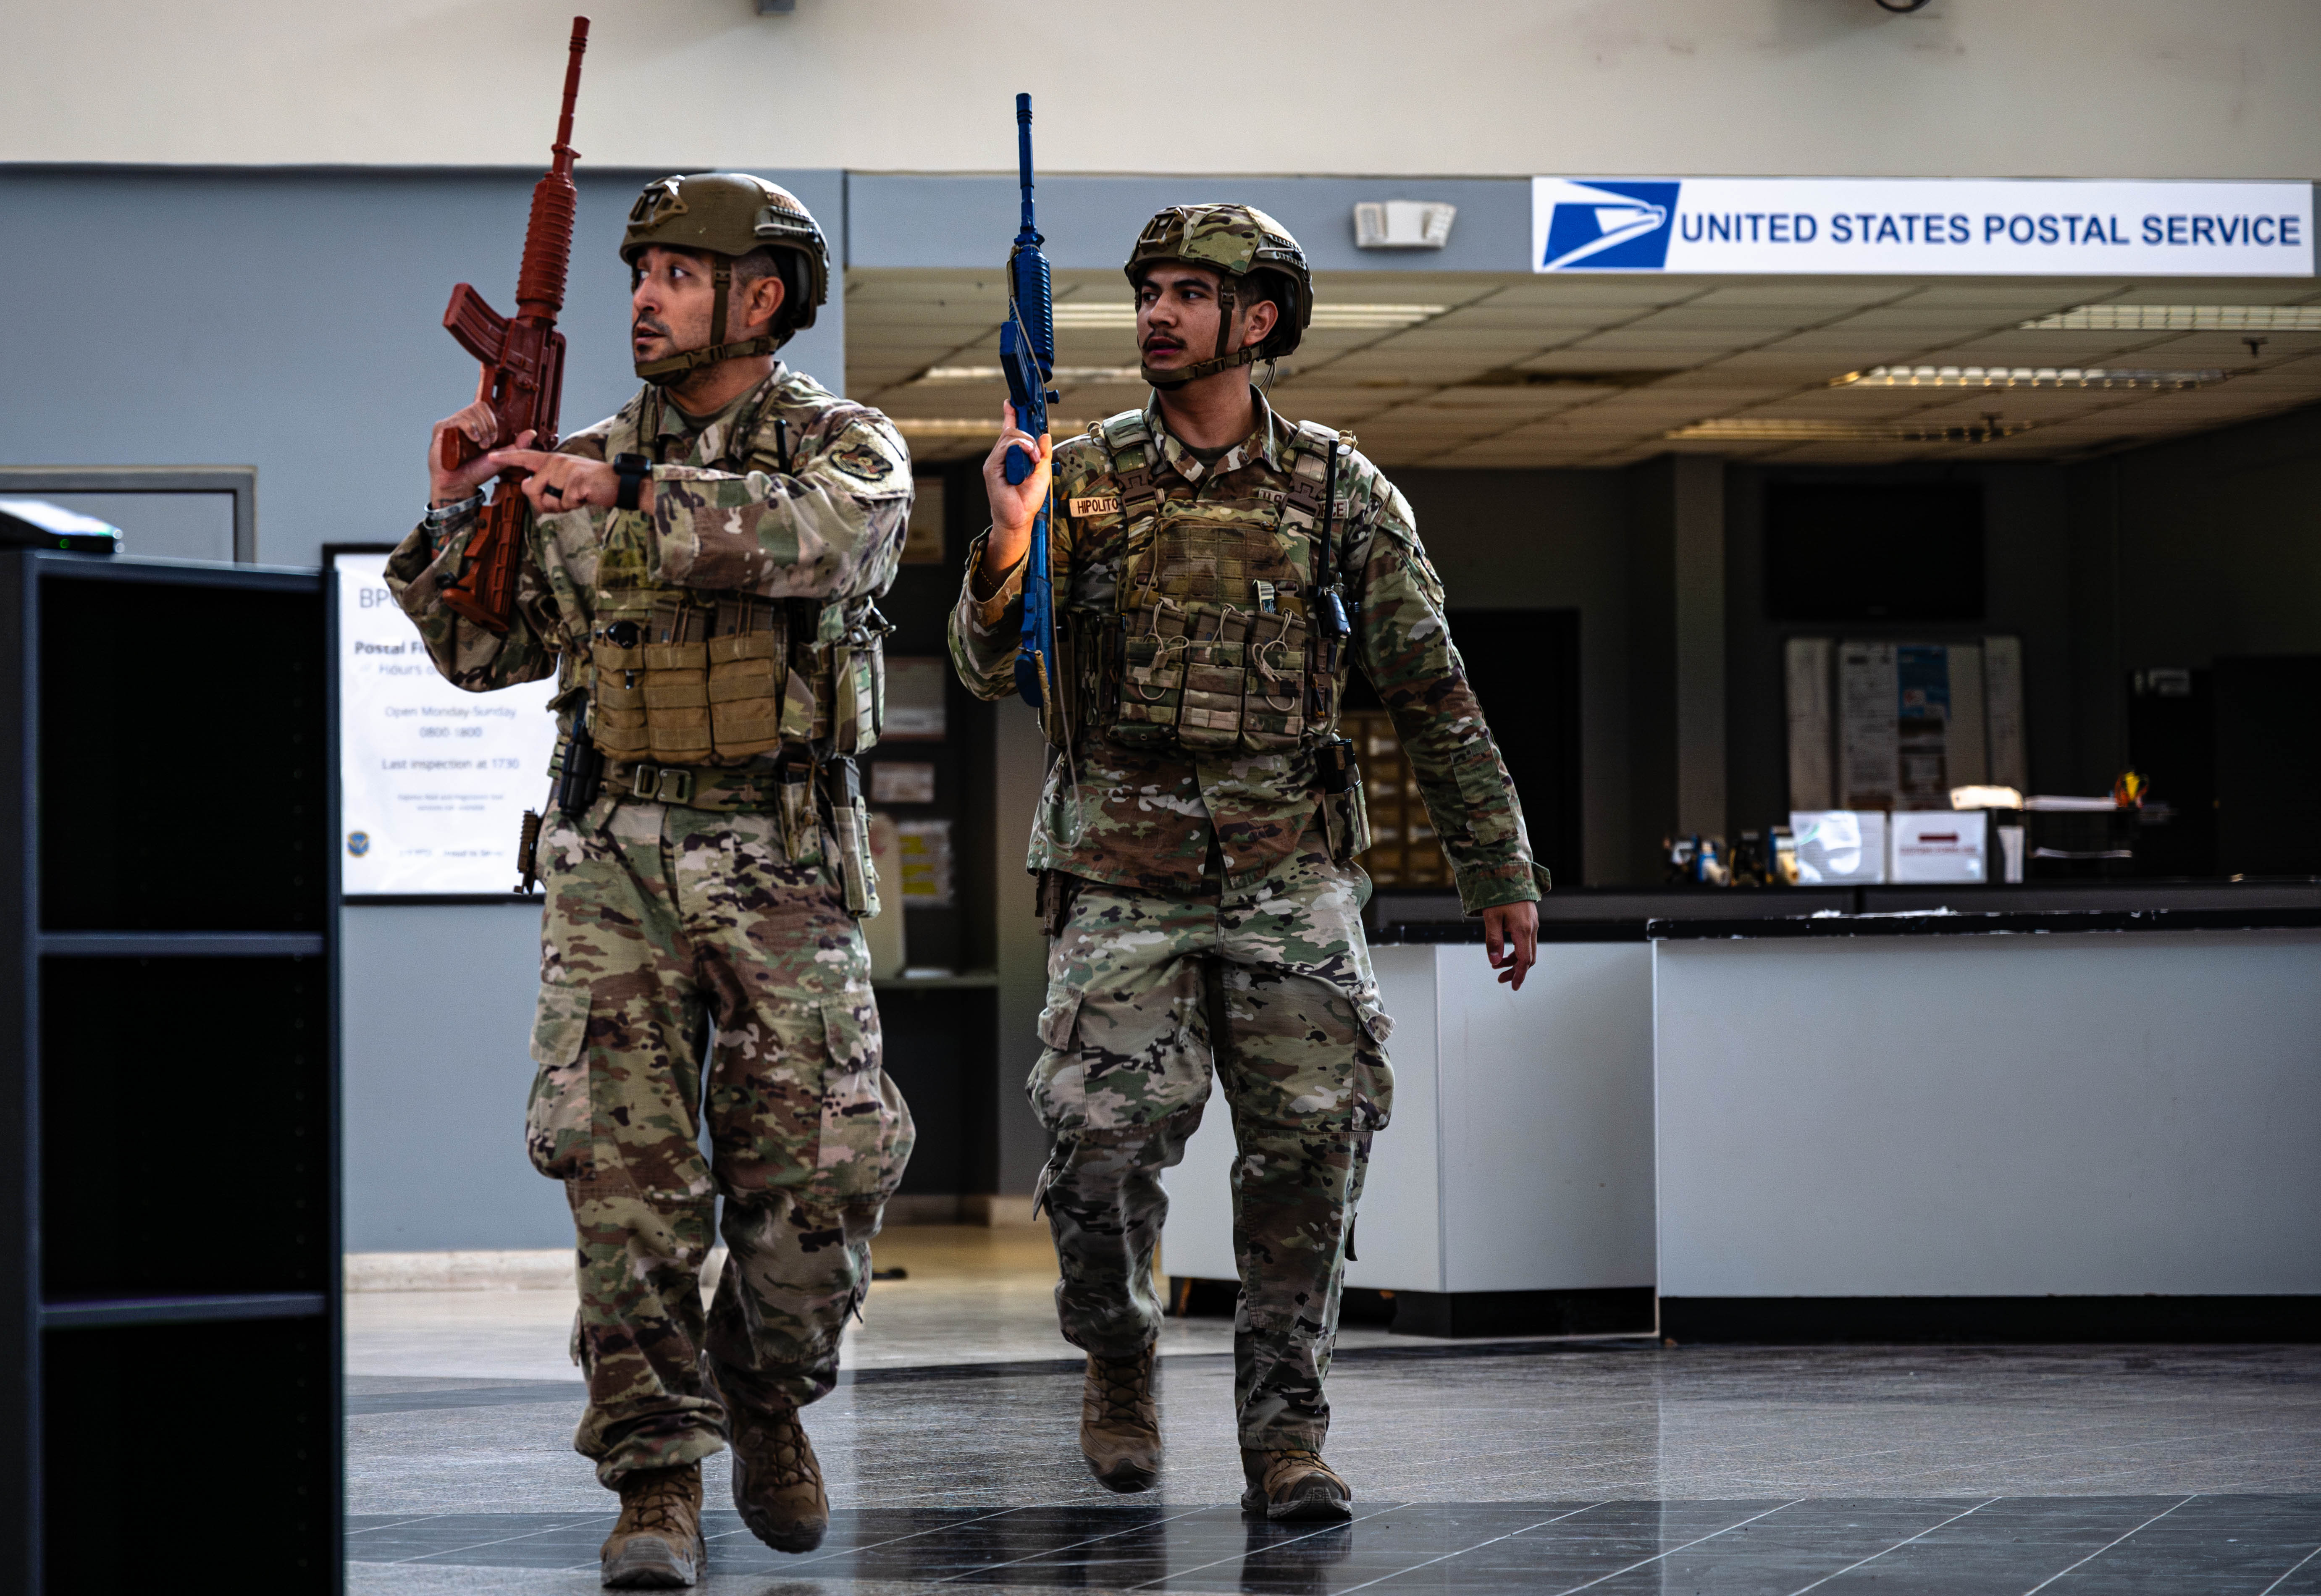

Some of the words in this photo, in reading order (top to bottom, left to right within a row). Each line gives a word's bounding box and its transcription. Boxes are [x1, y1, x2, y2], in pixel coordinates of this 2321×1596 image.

[1681, 213, 1818, 242] UNITED
[1830, 213, 1971, 244] STATES
[1983, 213, 2130, 245] POSTAL
[2141, 213, 2300, 246] SERVICE
[1077, 498, 1118, 514] HIPOLITO
[360, 588, 400, 607] BP
[355, 641, 405, 654] Postal
[385, 706, 417, 718] Open
[382, 759, 407, 769] Last
